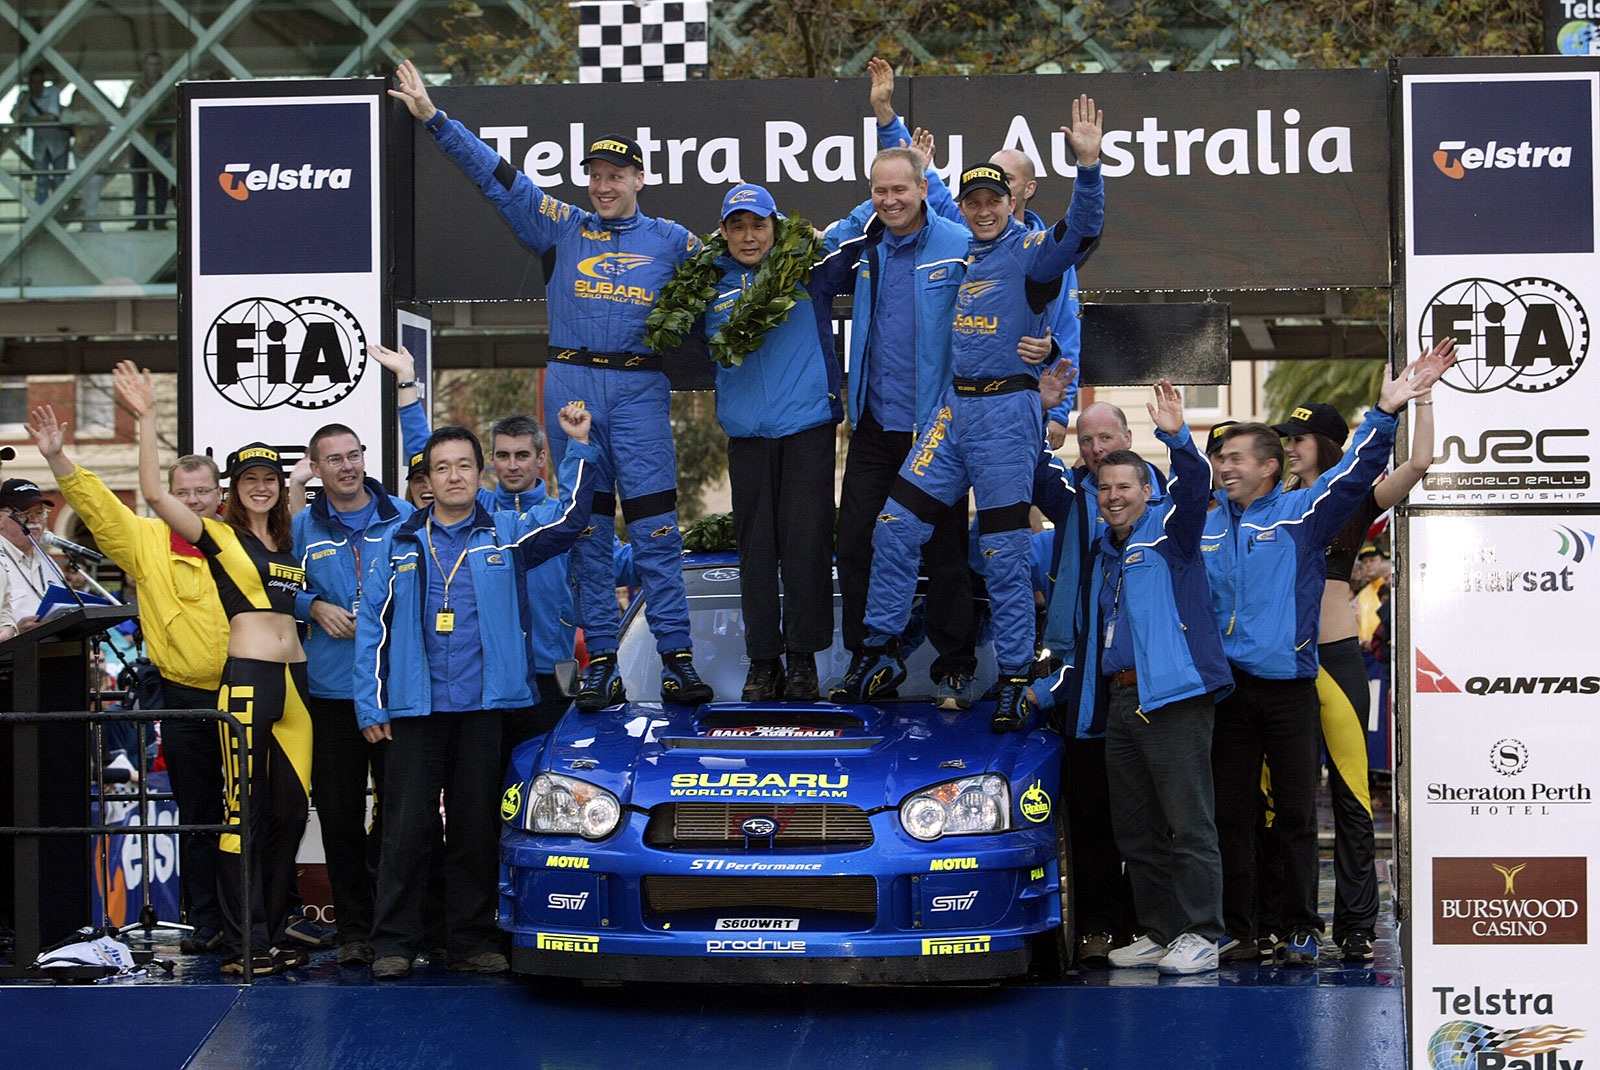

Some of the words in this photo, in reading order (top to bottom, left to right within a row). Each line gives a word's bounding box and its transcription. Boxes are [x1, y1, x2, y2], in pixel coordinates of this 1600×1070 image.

[479, 122, 741, 188] Teltra
[765, 116, 963, 199] Raly
[1001, 108, 1354, 177] Australia
[1433, 141, 1572, 180] Telstra
[219, 163, 352, 201] Telstra
[575, 279, 655, 302] SUBARU
[603, 293, 628, 303] RALLY
[1457, 476, 1520, 486] WORLD
[1525, 476, 1586, 485] RALLY
[1427, 493, 1586, 501] CHAMPIONSHIP
[1465, 676, 1600, 695] QANTAS
[670, 773, 849, 789] SUBARU
[670, 789, 733, 797] WORLD
[736, 789, 791, 797] RALLY
[795, 789, 848, 798] TEAM
[1427, 783, 1525, 800] Sheraton
[1531, 783, 1592, 800] Perth
[1470, 806, 1550, 815] HOTEL
[546, 855, 590, 869] MOTUL
[690, 859, 724, 870] STI
[725, 862, 822, 871] Performance
[930, 857, 978, 871] MOTUL
[1441, 898, 1578, 919] BURSWOOD
[721, 919, 794, 929] S600WRT
[1472, 921, 1547, 936] CASINO
[536, 932, 600, 953] PIRELLI
[707, 938, 806, 953] prodrive
[922, 935, 992, 956] PIRELLI
[1432, 986, 1553, 1015] Telstra
